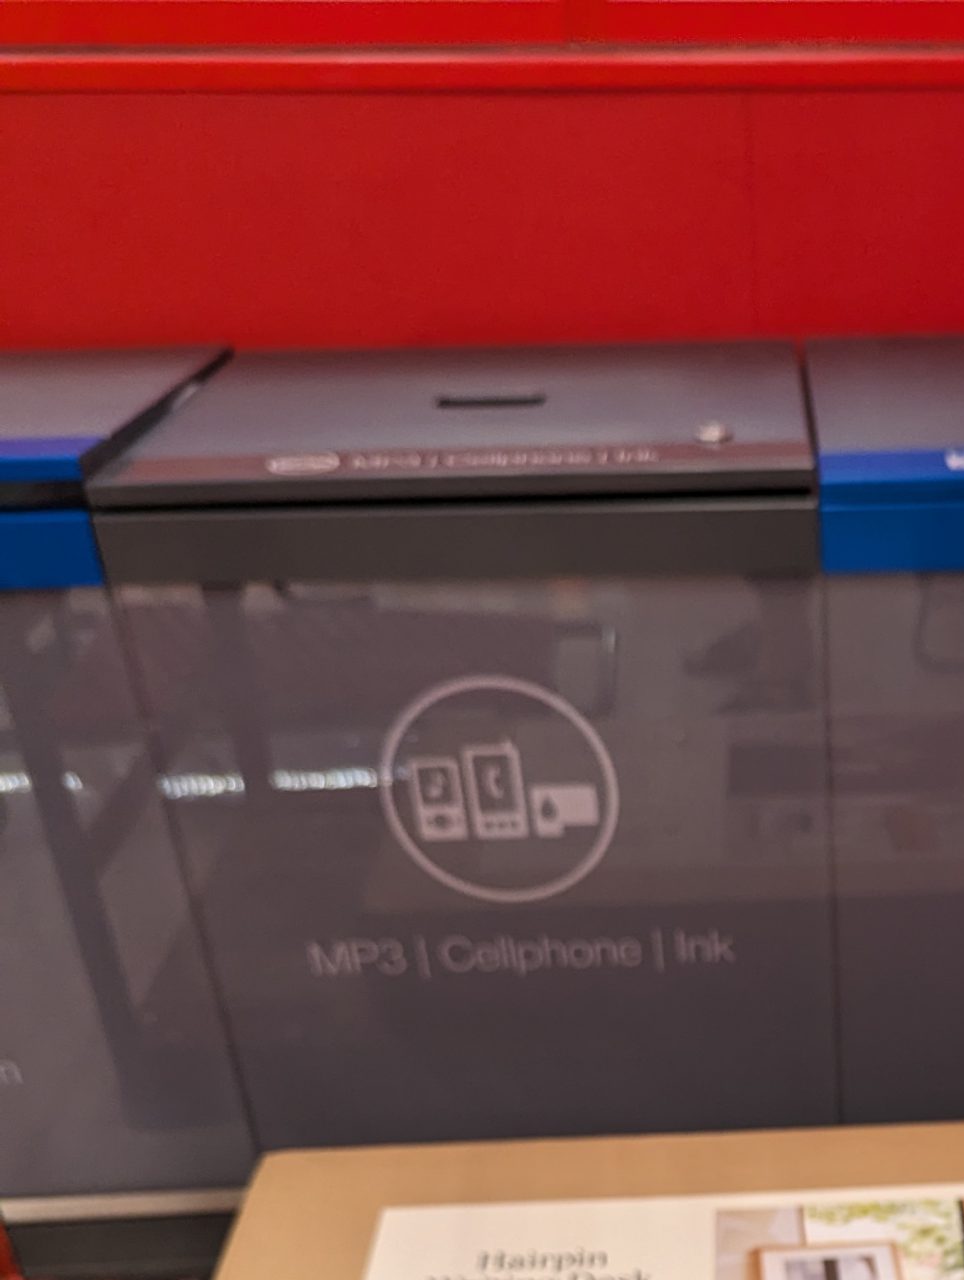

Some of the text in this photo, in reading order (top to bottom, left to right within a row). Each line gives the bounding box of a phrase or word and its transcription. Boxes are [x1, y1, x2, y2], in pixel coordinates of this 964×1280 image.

[306, 937, 408, 977] MP3
[439, 932, 643, 976] Cellphone
[672, 927, 738, 964] Ink
[475, 1246, 609, 1273] Hairpin
